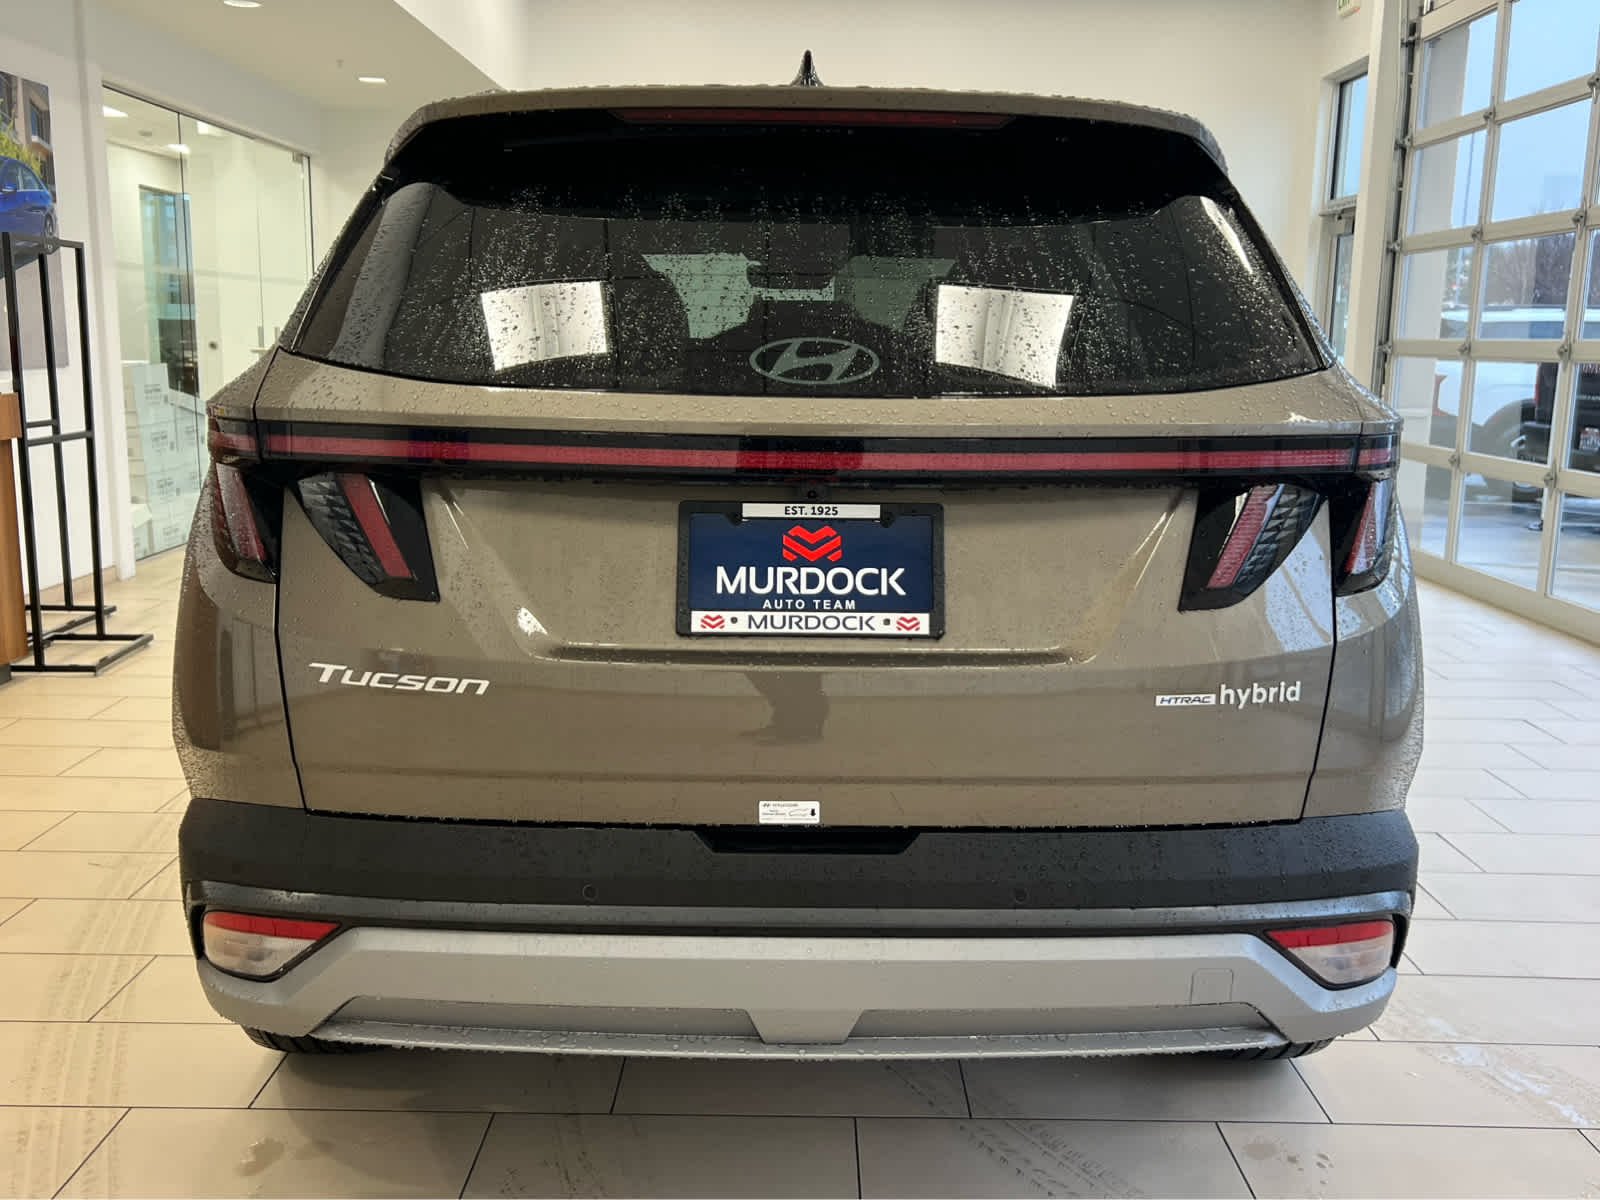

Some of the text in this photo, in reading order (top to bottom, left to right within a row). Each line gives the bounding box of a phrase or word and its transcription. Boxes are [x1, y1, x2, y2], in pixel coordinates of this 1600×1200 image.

[784, 505, 839, 516] EST. 1925
[716, 566, 906, 596] MURDOCK
[763, 599, 856, 610] AUTO TEAM
[748, 615, 876, 630] MURDOCK
[1159, 681, 1301, 709] HTRAC hybrid
